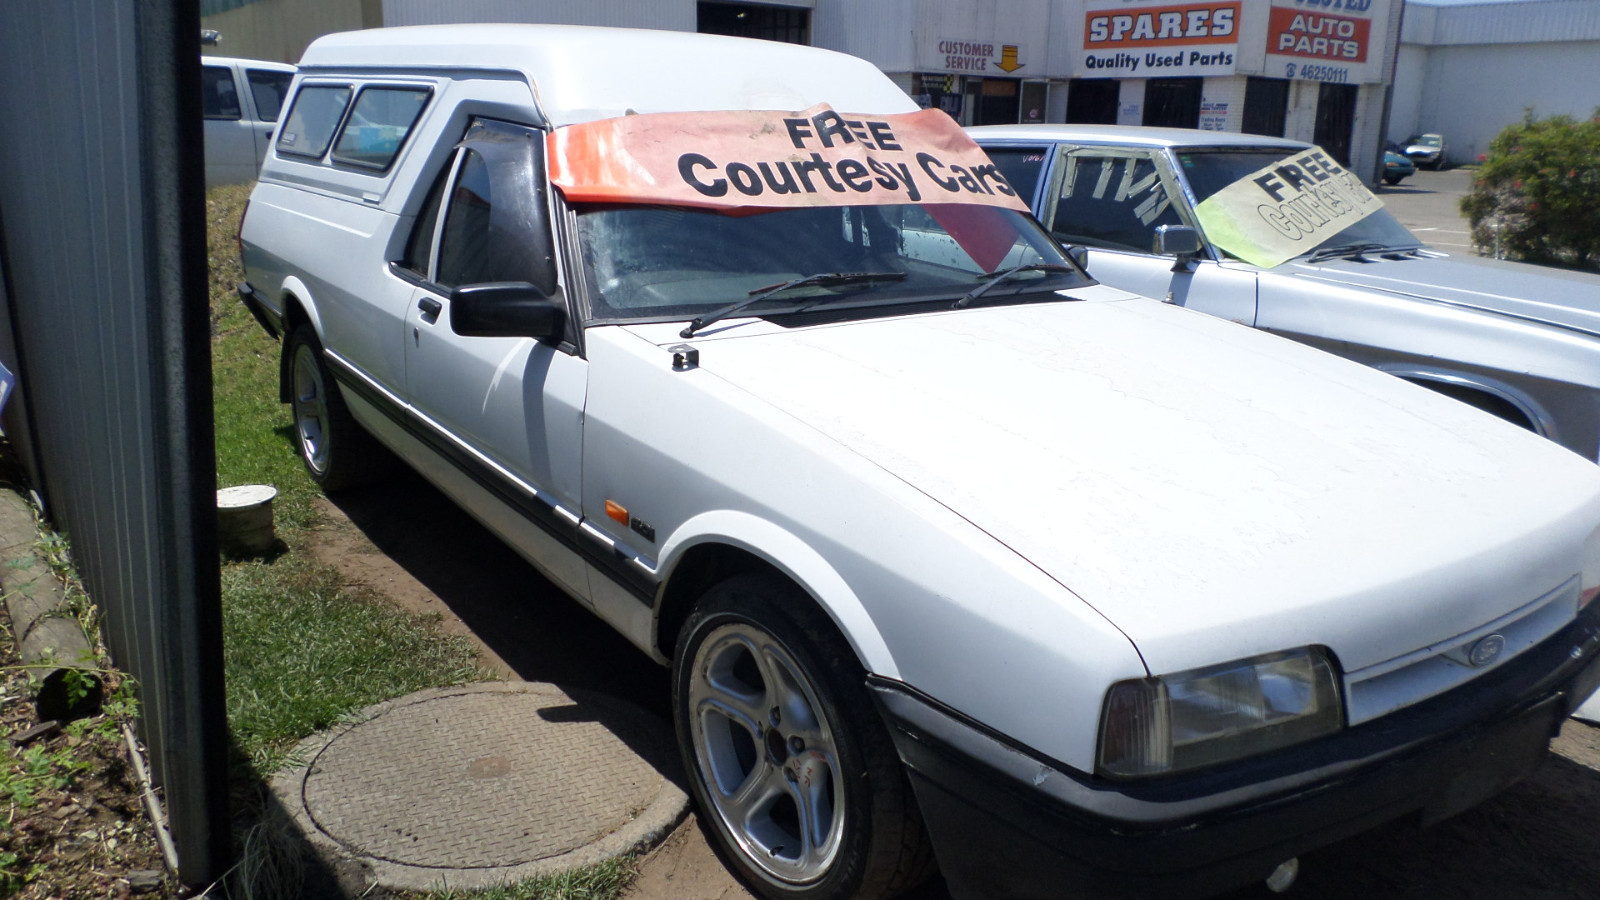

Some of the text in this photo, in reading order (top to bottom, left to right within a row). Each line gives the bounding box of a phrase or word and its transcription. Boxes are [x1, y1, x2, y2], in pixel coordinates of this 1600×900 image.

[1089, 7, 1236, 42] SPARES
[1289, 13, 1355, 38] AUTO
[939, 41, 994, 57] CUSTOMER
[1279, 33, 1360, 58] PARTS
[945, 56, 987, 71] SERVICE
[1085, 51, 1233, 71] Quality Used Parts
[1300, 64, 1349, 83] 46250111
[783, 110, 903, 151] FREE
[677, 152, 1016, 201] Courtesy Cars
[1253, 152, 1342, 202] FREE
